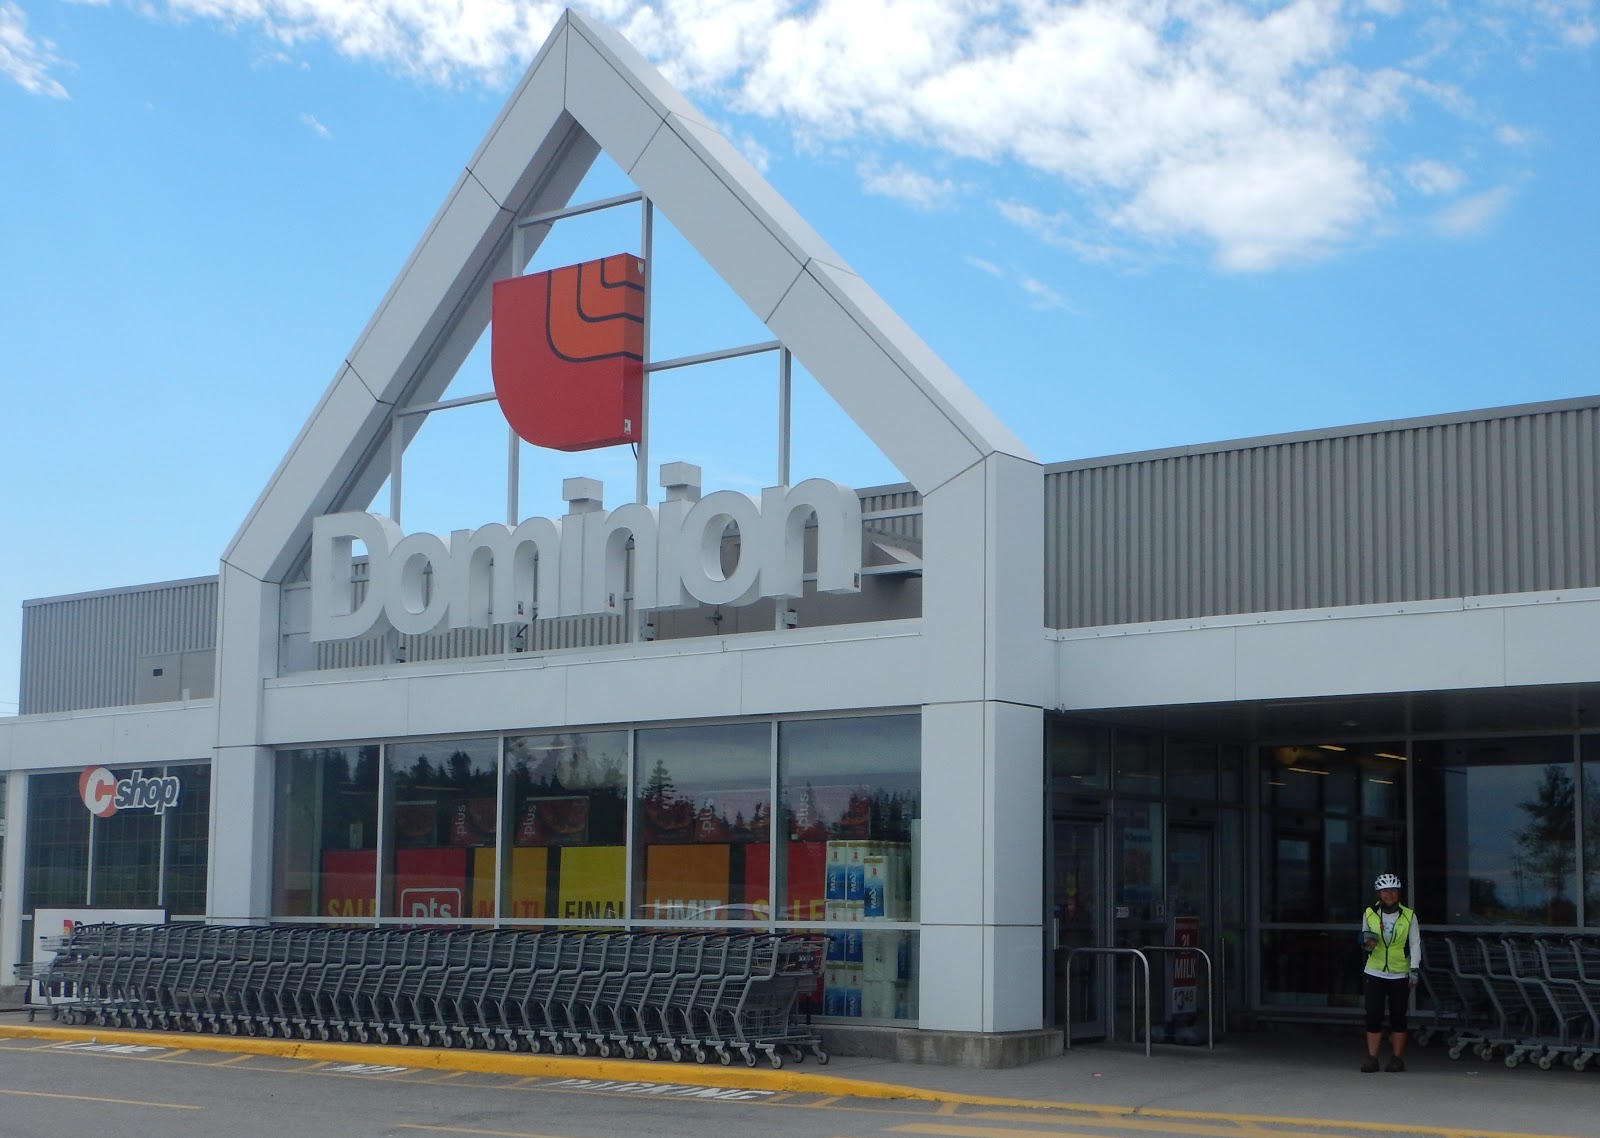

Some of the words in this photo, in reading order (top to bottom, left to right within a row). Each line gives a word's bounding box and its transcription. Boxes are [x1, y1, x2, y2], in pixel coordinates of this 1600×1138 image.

[311, 462, 862, 643] Dominion
[455, 804, 468, 836] plus
[523, 805, 537, 836] plus
[849, 871, 857, 893] MAX
[868, 886, 877, 909] MAX
[412, 898, 453, 928] pts
[479, 901, 541, 926] MLTI
[655, 901, 723, 934] LIMIT
[752, 900, 825, 934] SLE
[1174, 958, 1196, 979] MILK
[534, 1078, 776, 1099] PARKING
